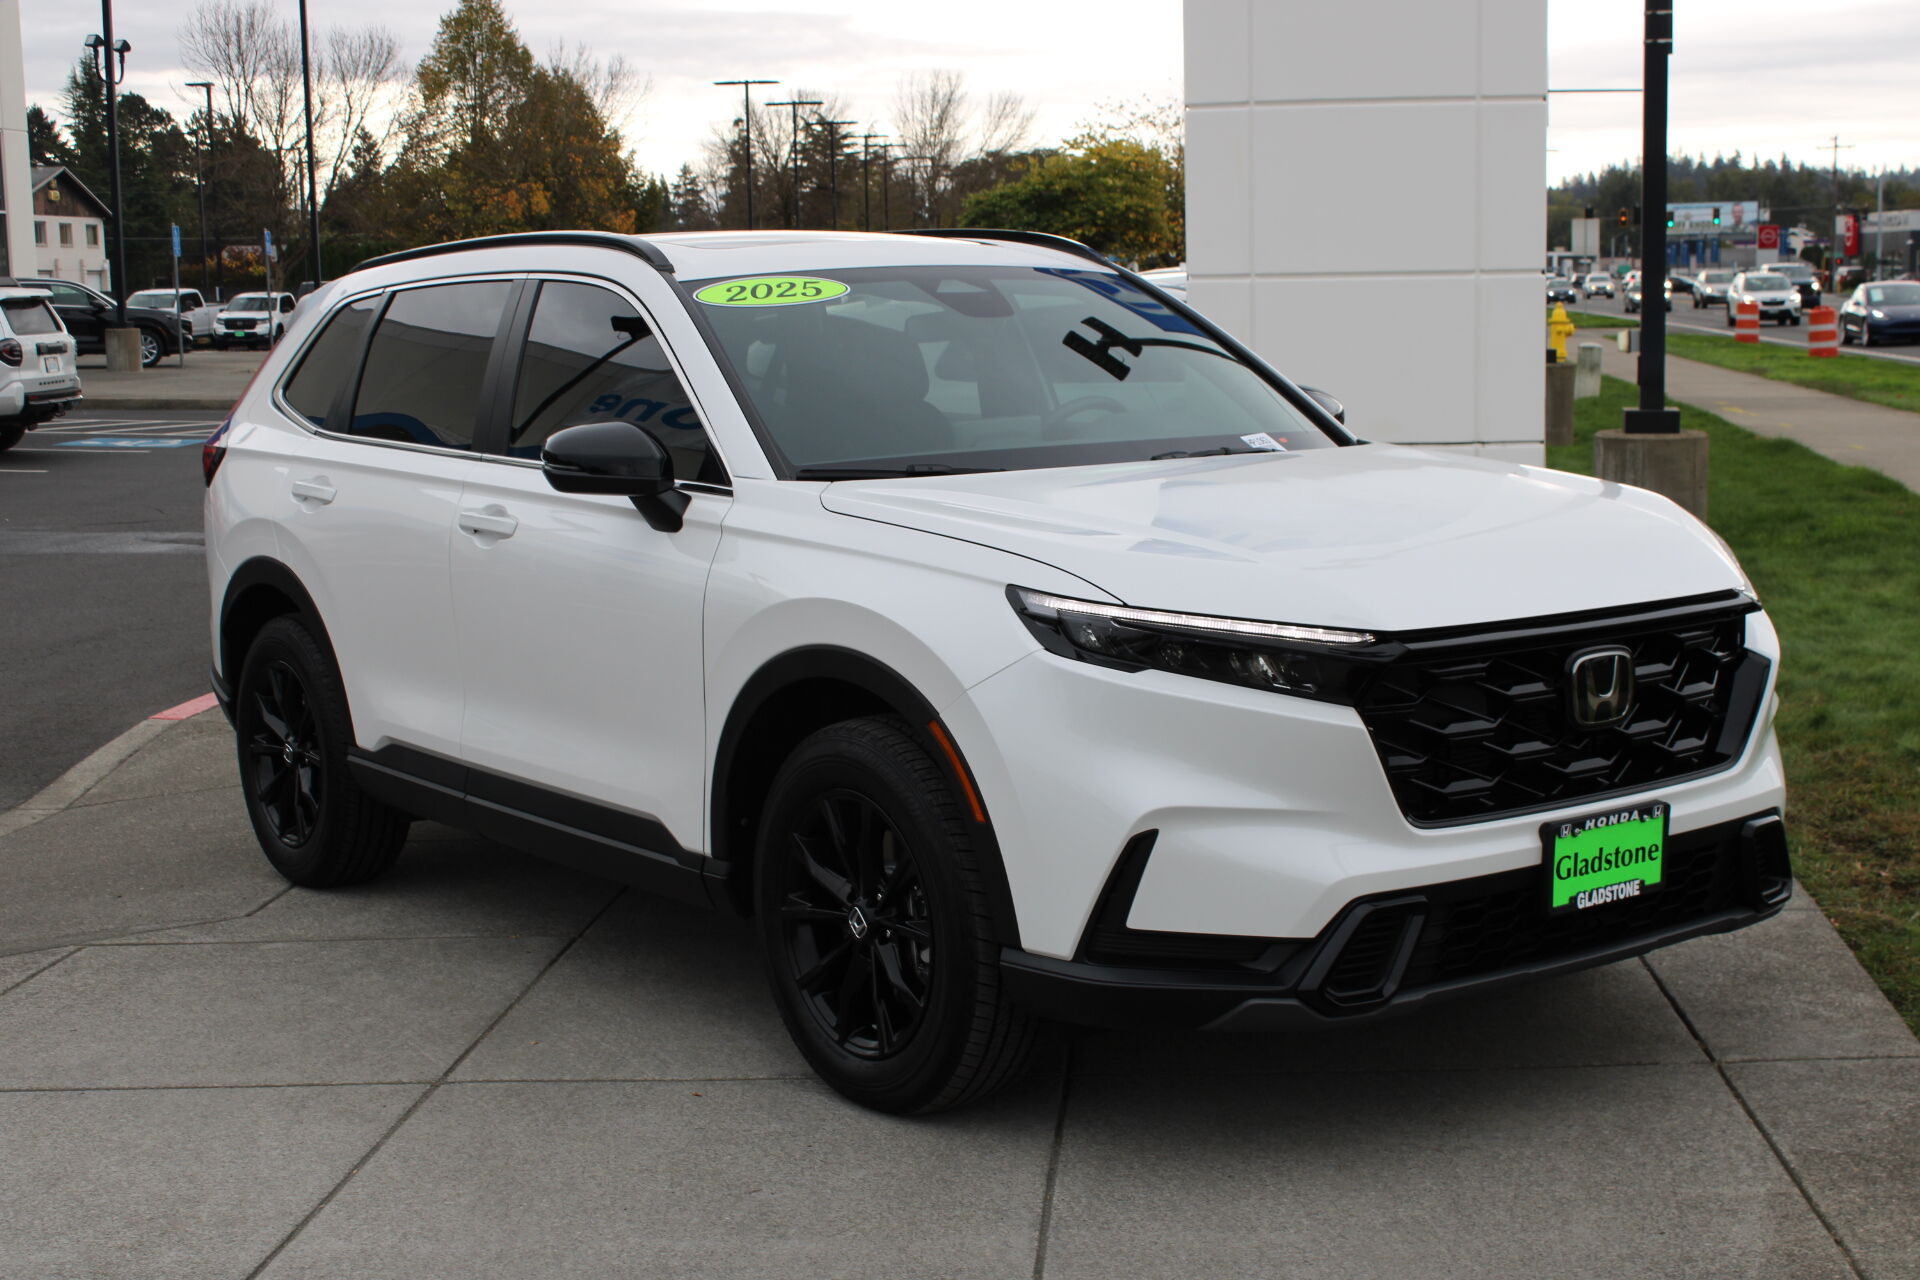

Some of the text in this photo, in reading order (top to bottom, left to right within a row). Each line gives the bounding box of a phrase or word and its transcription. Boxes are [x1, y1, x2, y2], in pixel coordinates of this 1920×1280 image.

[726, 281, 823, 303] 2025
[1585, 809, 1640, 831] HONDA
[1555, 842, 1660, 881] Gladstone
[1576, 879, 1641, 910] GLADSTONE
